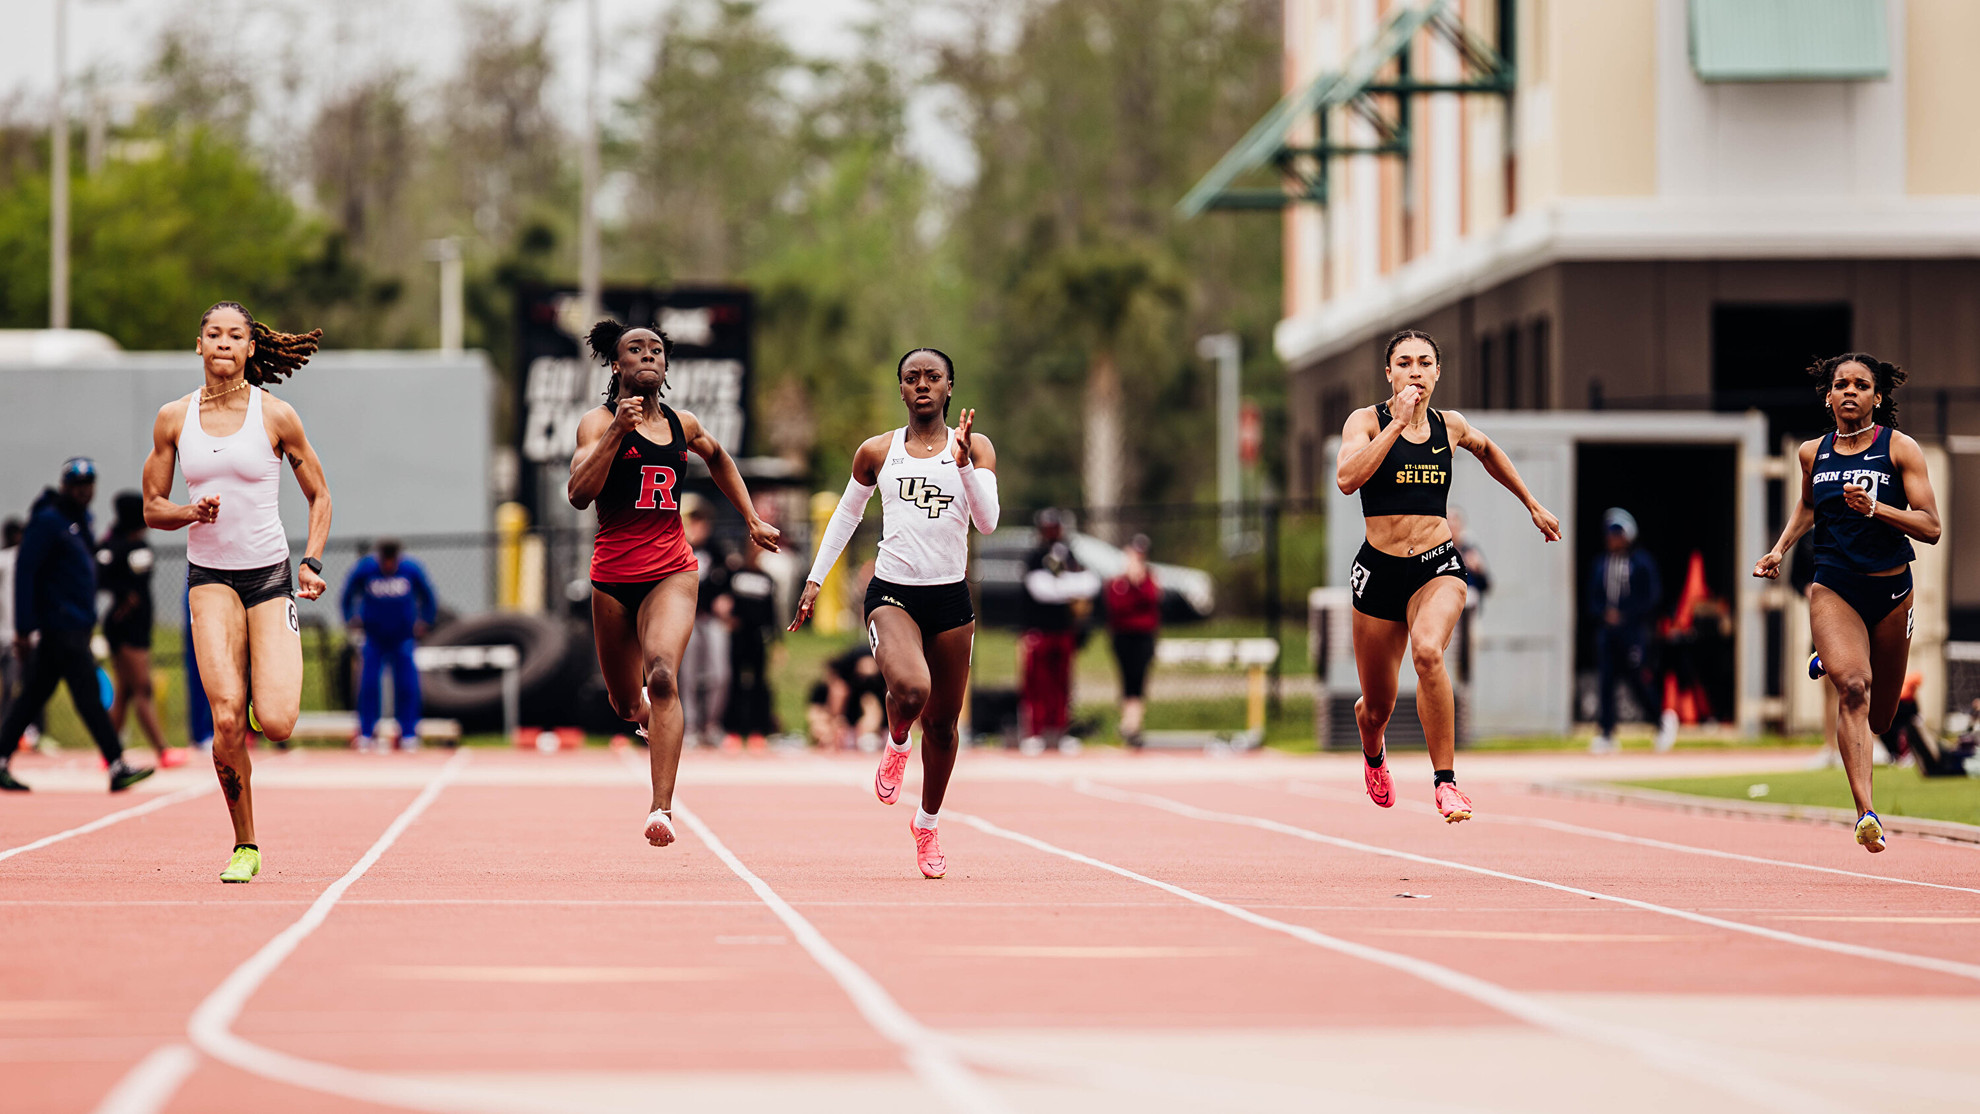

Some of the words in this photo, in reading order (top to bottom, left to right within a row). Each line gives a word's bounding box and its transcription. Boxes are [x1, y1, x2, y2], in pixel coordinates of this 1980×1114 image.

[635, 465, 678, 511] R
[1396, 471, 1446, 484] SELECT
[1812, 471, 1841, 486] ENN
[895, 477, 955, 519] UCF
[1421, 545, 1445, 563] NIKE
[288, 603, 298, 632] 6
